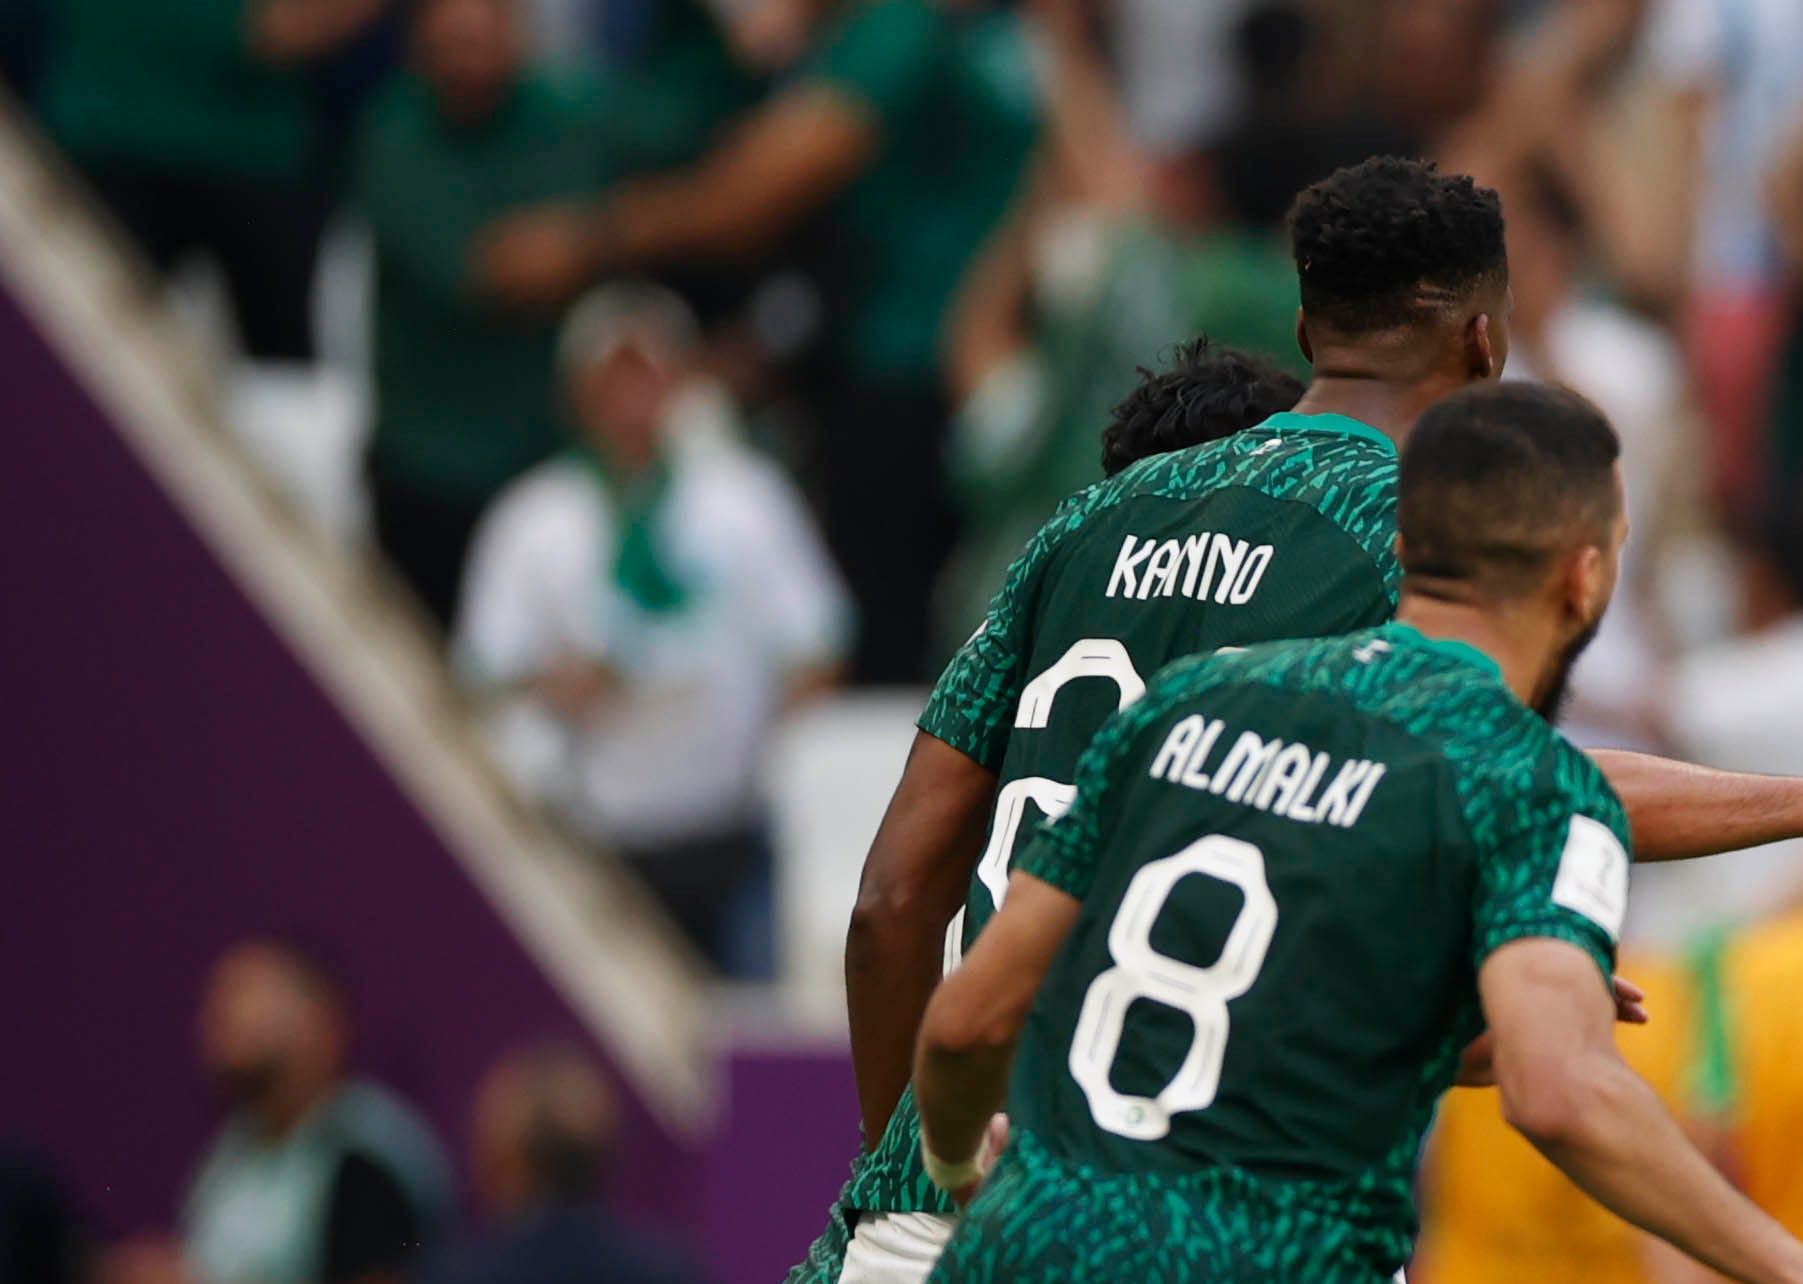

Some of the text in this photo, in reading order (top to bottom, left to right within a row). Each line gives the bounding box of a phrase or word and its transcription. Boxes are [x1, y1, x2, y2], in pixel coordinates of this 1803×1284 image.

[1105, 531, 1274, 605] KANNO
[976, 638, 1248, 914] 2
[1149, 713, 1387, 829] ALMALKI
[1068, 834, 1279, 1141] 8
